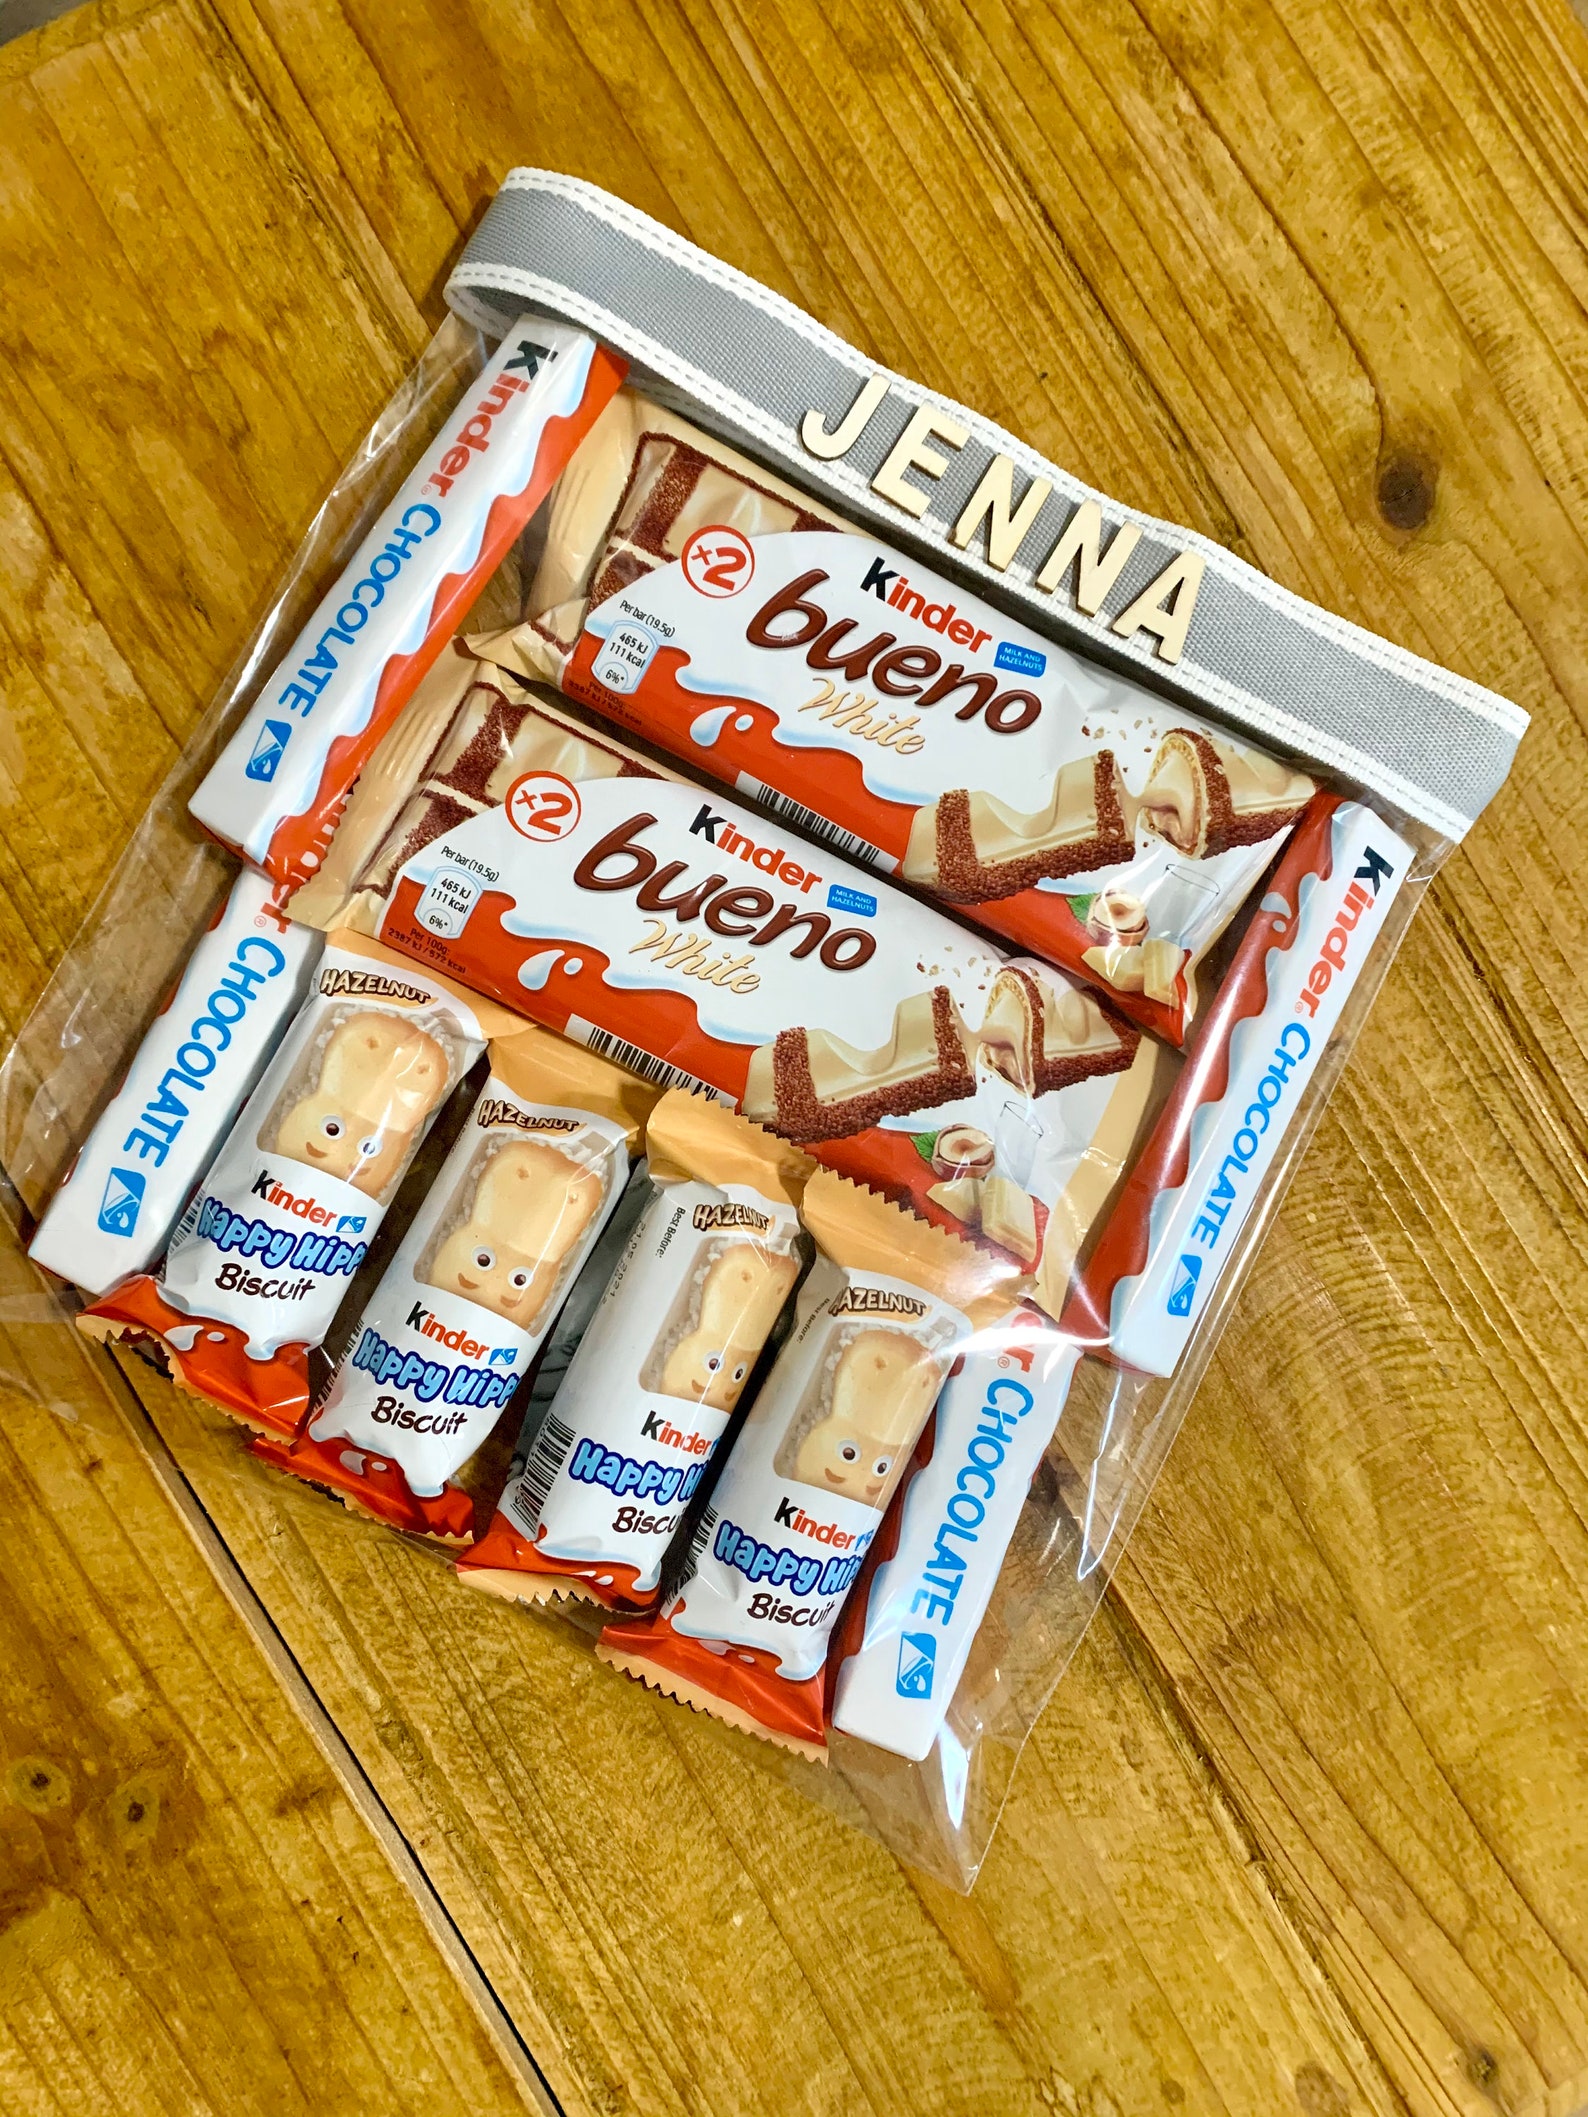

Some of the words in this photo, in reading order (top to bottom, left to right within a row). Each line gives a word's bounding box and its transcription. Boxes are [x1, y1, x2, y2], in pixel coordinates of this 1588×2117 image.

[800, 373, 1206, 664] JENNA
[278, 503, 441, 717] CHOCOLATE
[620, 600, 632, 613] Per
[633, 607, 646, 621] bar
[645, 614, 676, 638] (19.5g)
[610, 642, 626, 657] 111
[626, 652, 646, 668] kcal
[619, 633, 637, 647] 465
[637, 642, 648, 654] kJ
[746, 568, 1042, 734] bueno
[1004, 647, 1024, 659] MILK
[1024, 652, 1041, 663] AND
[999, 654, 1042, 672] HAZELNUTS
[797, 677, 926, 755] White
[441, 846, 454, 859] Per
[454, 853, 470, 866] bar
[468, 859, 500, 883] (19.5g)
[430, 888, 448, 903] 111
[448, 897, 470, 914] kcal
[441, 878, 459, 893] 465
[460, 886, 471, 900] kJ
[573, 812, 877, 971] bueno
[830, 895, 874, 913] HAZELNUTS
[835, 889, 855, 900] MILK
[855, 894, 872, 905] AND
[388, 927, 411, 945] 2387
[428, 950, 447, 964] 572
[447, 959, 467, 974] kcal
[410, 928, 424, 940] Per
[628, 918, 761, 994] White
[319, 968, 431, 1004] HAZELNUT
[123, 937, 286, 1168] CHOCOLATE
[477, 1099, 580, 1132] HAZELNUT
[1190, 1021, 1311, 1249] CHOCOLATE
[672, 1206, 686, 1228] Best
[692, 1203, 769, 1232] HAZELNUT
[197, 1196, 298, 1269] Happy
[289, 1231, 368, 1277] Hipp
[655, 1226, 677, 1258] Before:
[215, 1262, 316, 1301] Biscuit
[352, 1327, 450, 1403] Happy
[442, 1365, 522, 1408] Hipp
[370, 1396, 468, 1435] Biscuit
[568, 1437, 684, 1506] Happy
[611, 1506, 685, 1535] Biscu
[910, 1378, 1034, 1626] CHOCOLATE
[713, 1519, 823, 1596] Happy
[818, 1554, 864, 1596] Hip
[746, 1592, 836, 1627] Biscuit
